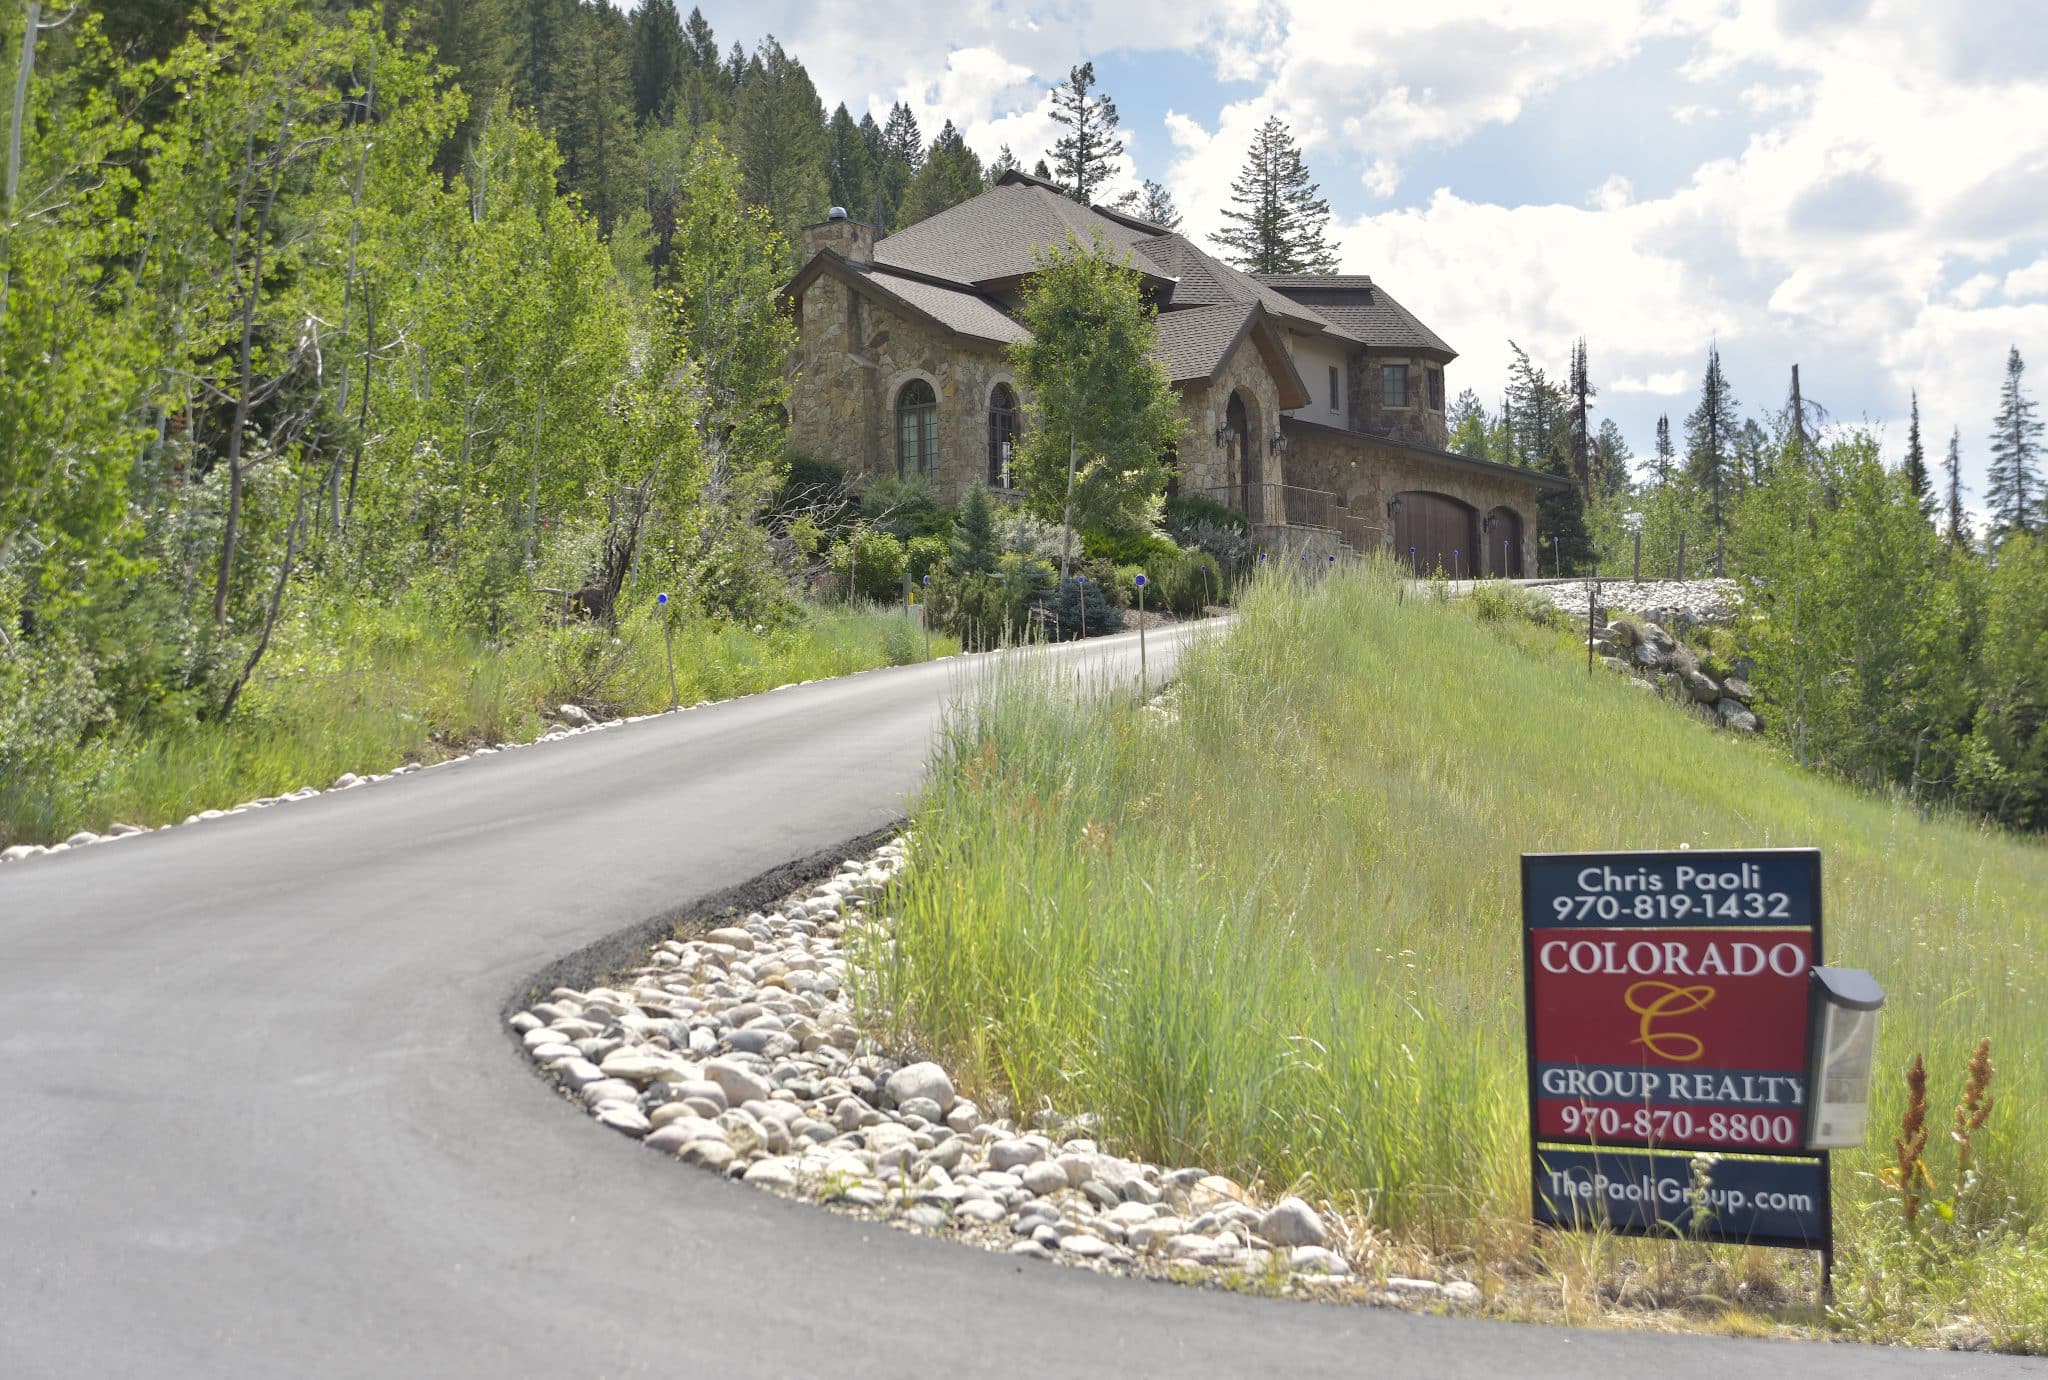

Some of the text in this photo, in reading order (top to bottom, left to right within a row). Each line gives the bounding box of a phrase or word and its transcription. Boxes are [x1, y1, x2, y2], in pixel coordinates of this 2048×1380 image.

[1577, 863, 1761, 893] Chris Paoli
[1552, 892, 1790, 920] 970-819-1432
[1540, 940, 1805, 977] COLORADO
[1542, 1068, 1804, 1104] GROUP REALTY
[1561, 1105, 1793, 1144] 970-870-8800
[1551, 1170, 1812, 1214] ThePaoliGroup.com
